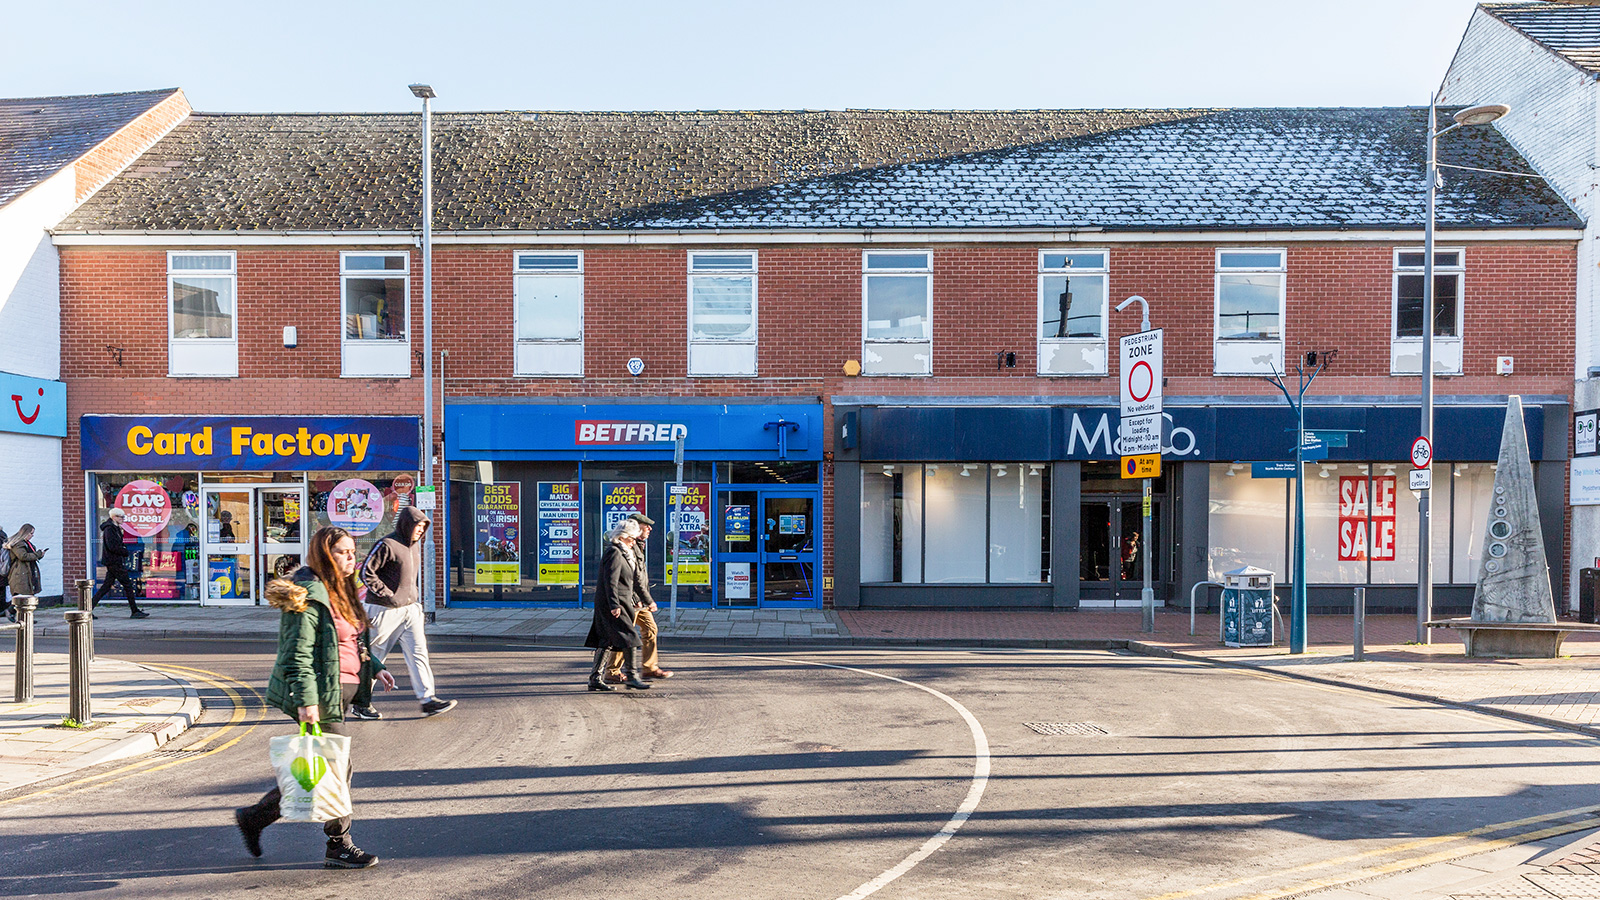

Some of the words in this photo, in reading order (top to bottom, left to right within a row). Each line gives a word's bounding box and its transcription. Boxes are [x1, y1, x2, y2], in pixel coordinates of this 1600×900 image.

[1124, 333, 1158, 346] PEDESTRIAN
[1129, 344, 1153, 358] ZONE
[1129, 419, 1145, 427] Except
[579, 424, 688, 442] BETFRED
[1132, 427, 1149, 435] loading
[126, 425, 213, 456] Card
[231, 426, 371, 463] Factory
[552, 484, 570, 494] BIG
[1411, 480, 1428, 488] cycling
[484, 485, 511, 495] BEST
[612, 487, 636, 495] ACCA
[483, 495, 512, 504] ODDS
[605, 495, 642, 505] BOOST
[1341, 480, 1394, 517] SALE
[477, 515, 489, 523] UK
[496, 515, 518, 523] IRISH
[612, 513, 630, 523] 50
[1341, 521, 1393, 558] SALE
[824, 578, 833, 588] H
